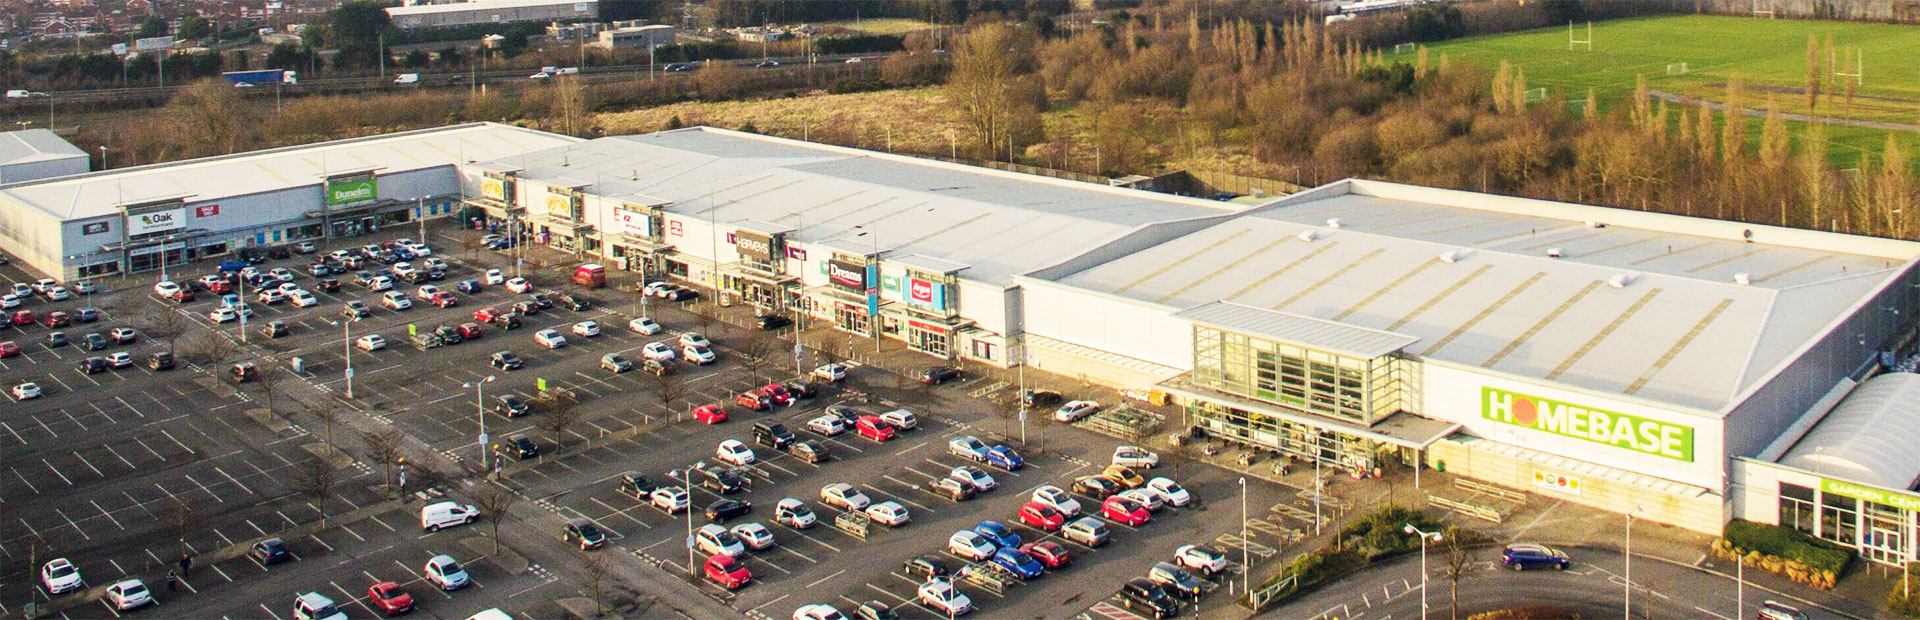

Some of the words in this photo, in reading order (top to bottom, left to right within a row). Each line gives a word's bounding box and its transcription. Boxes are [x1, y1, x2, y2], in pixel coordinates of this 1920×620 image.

[153, 213, 172, 223] Oak
[829, 263, 863, 282] Dreams
[1488, 390, 1684, 459] HOMEBASE
[1829, 483, 1882, 501] GARDEN
